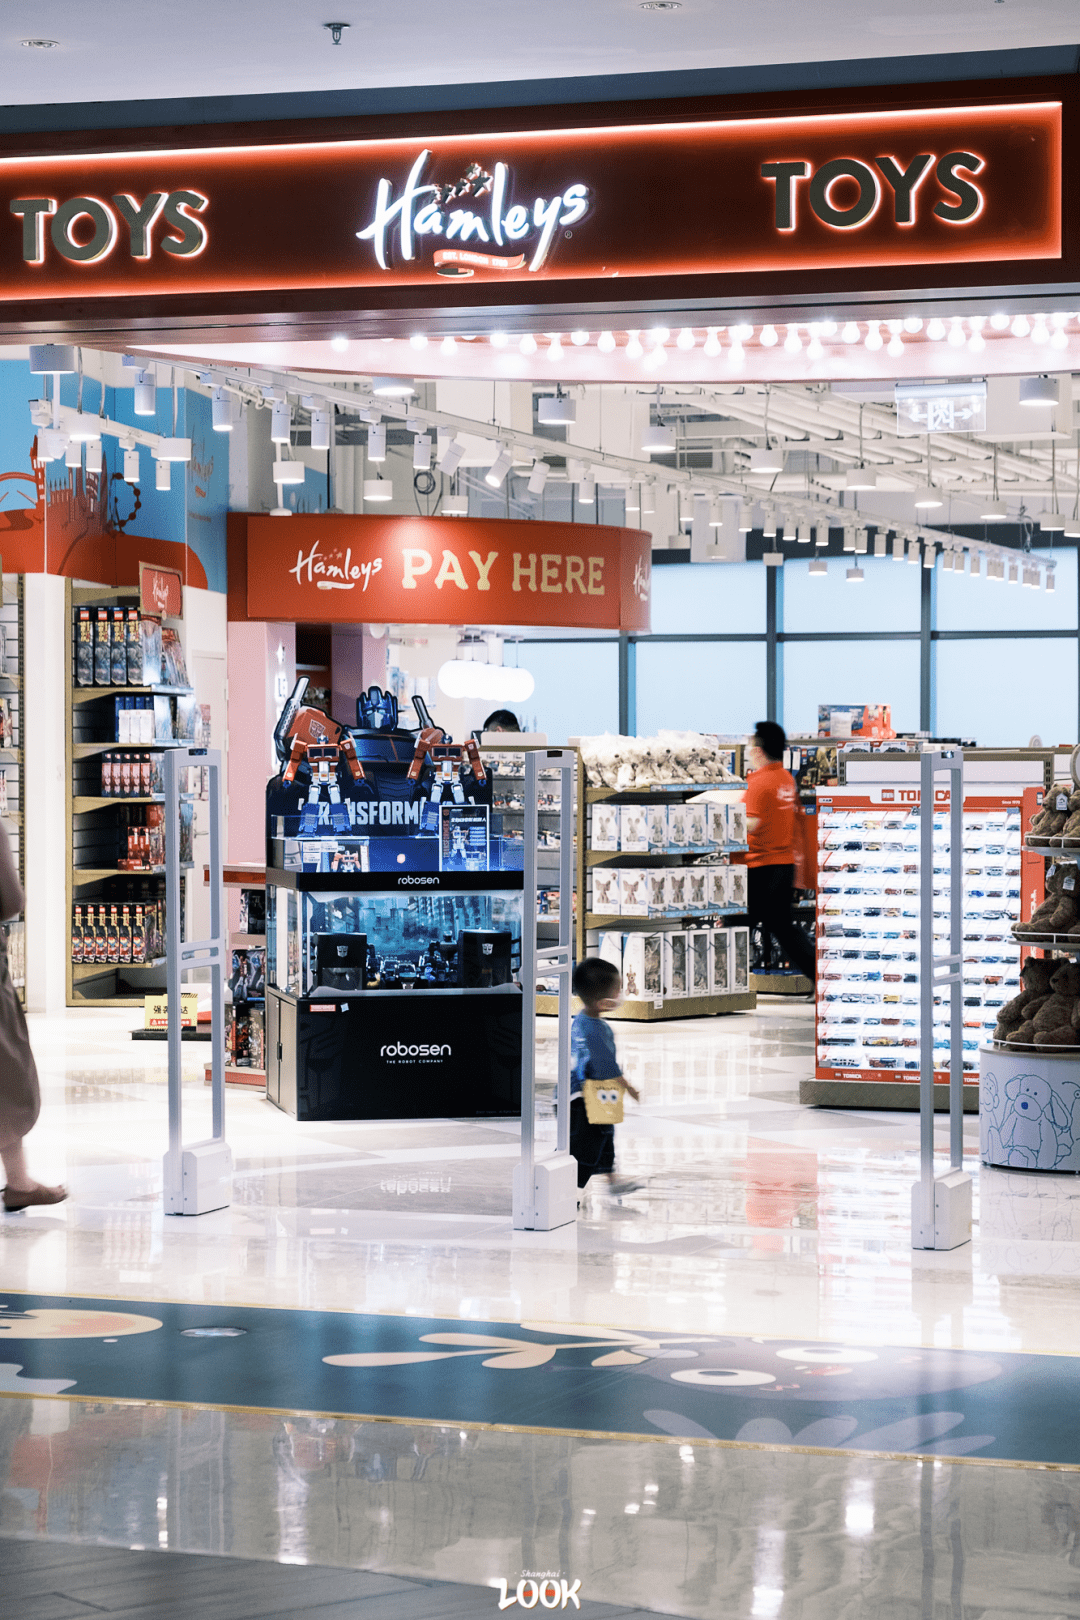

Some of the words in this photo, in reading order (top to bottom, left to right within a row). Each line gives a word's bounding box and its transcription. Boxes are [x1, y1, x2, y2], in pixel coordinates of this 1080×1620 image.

[355, 148, 590, 272] Hamleys
[761, 151, 986, 232] TOYS
[10, 189, 209, 265] TOYS
[288, 539, 384, 593] Hamleys
[400, 548, 499, 591] PAY
[511, 552, 606, 596] HERE
[898, 789, 951, 801] TOCA
[397, 874, 440, 885] robosen
[380, 1040, 452, 1057] robosen
